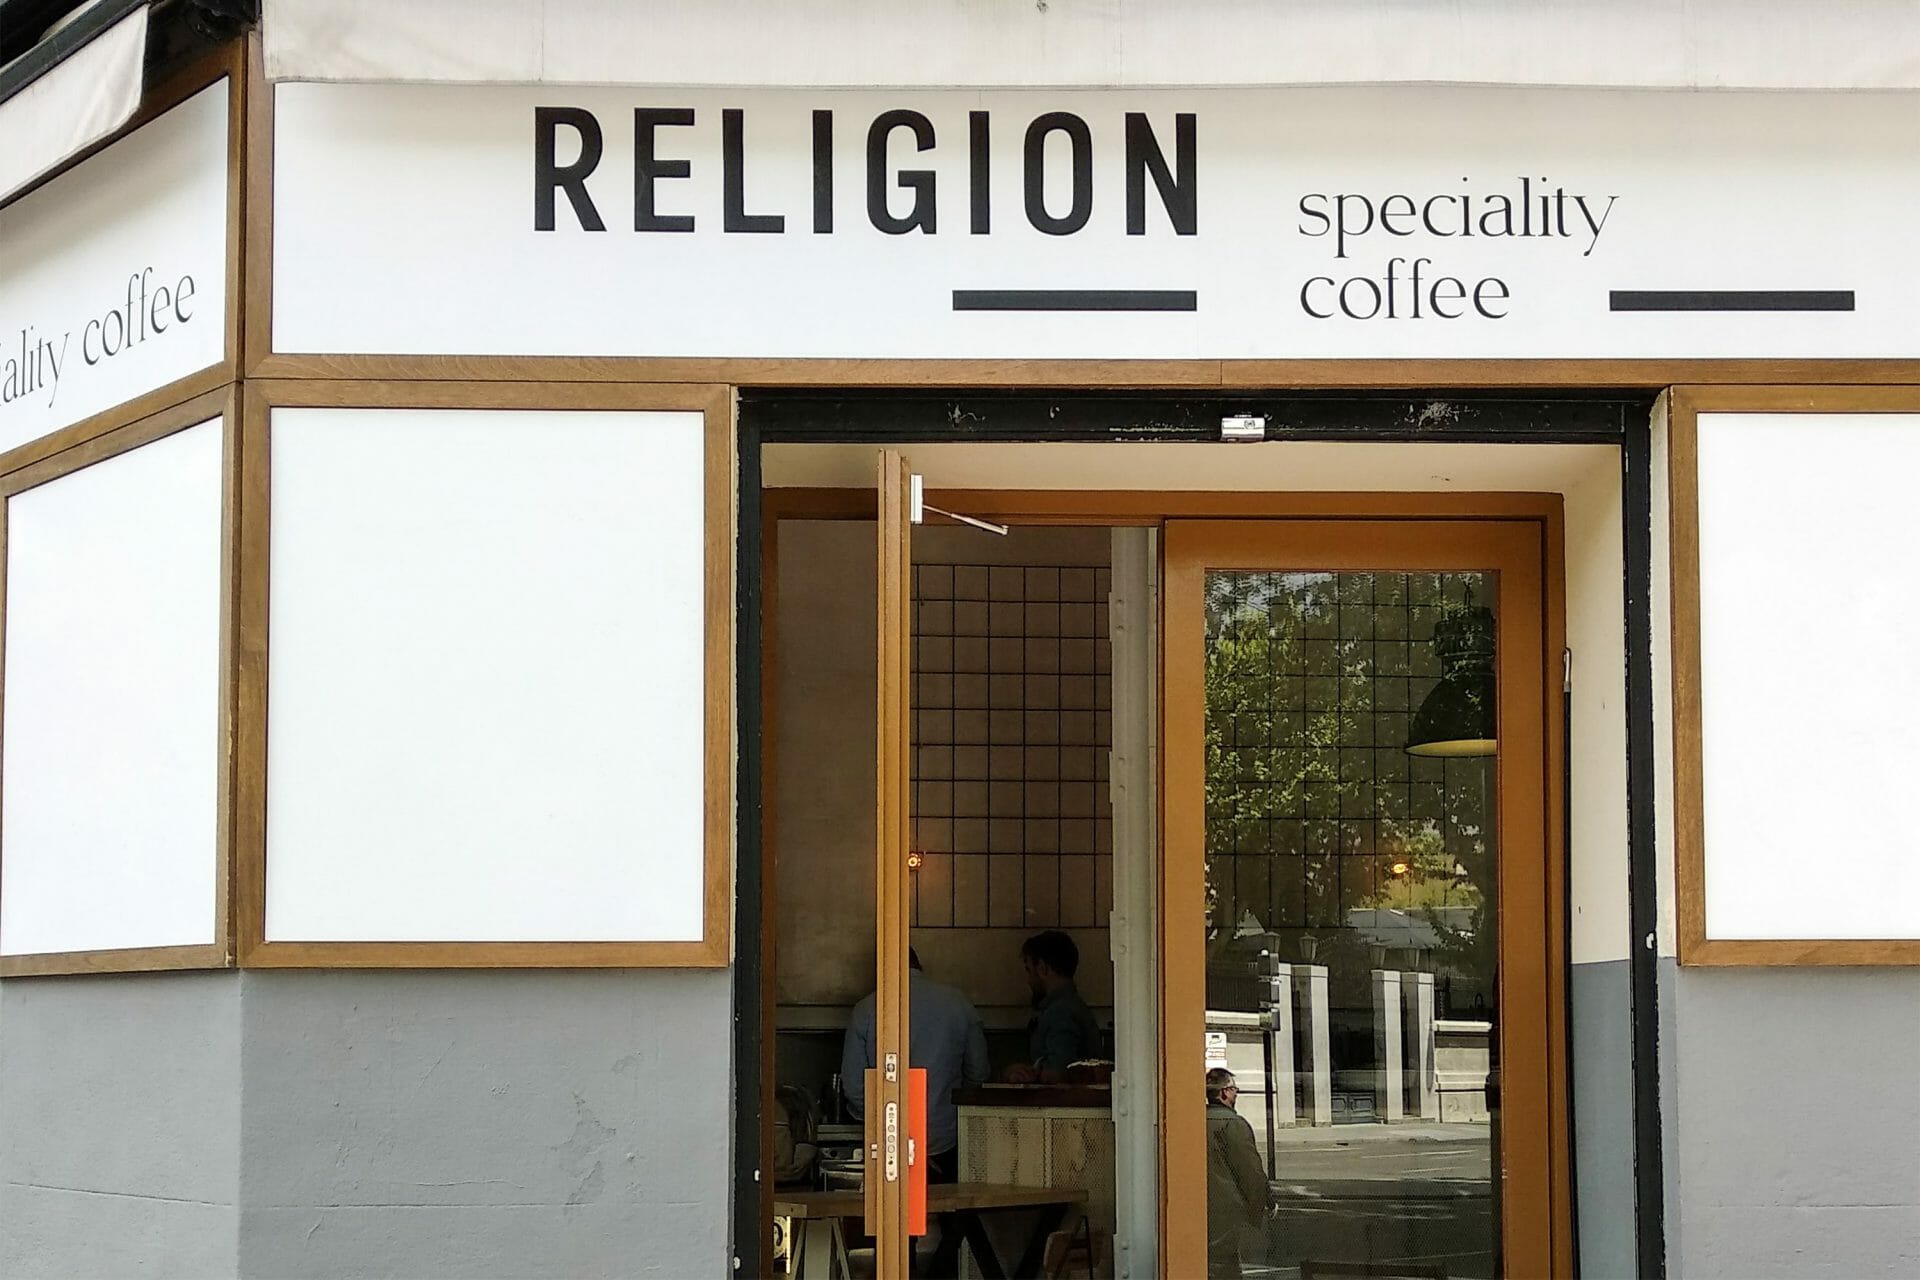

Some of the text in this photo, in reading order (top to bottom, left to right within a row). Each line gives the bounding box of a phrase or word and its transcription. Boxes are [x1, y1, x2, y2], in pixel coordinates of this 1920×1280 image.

[535, 107, 1197, 235] RELIGION
[1299, 177, 1619, 258] speciality
[0, 266, 196, 409] ality coffee
[1301, 257, 1510, 319] coffee
